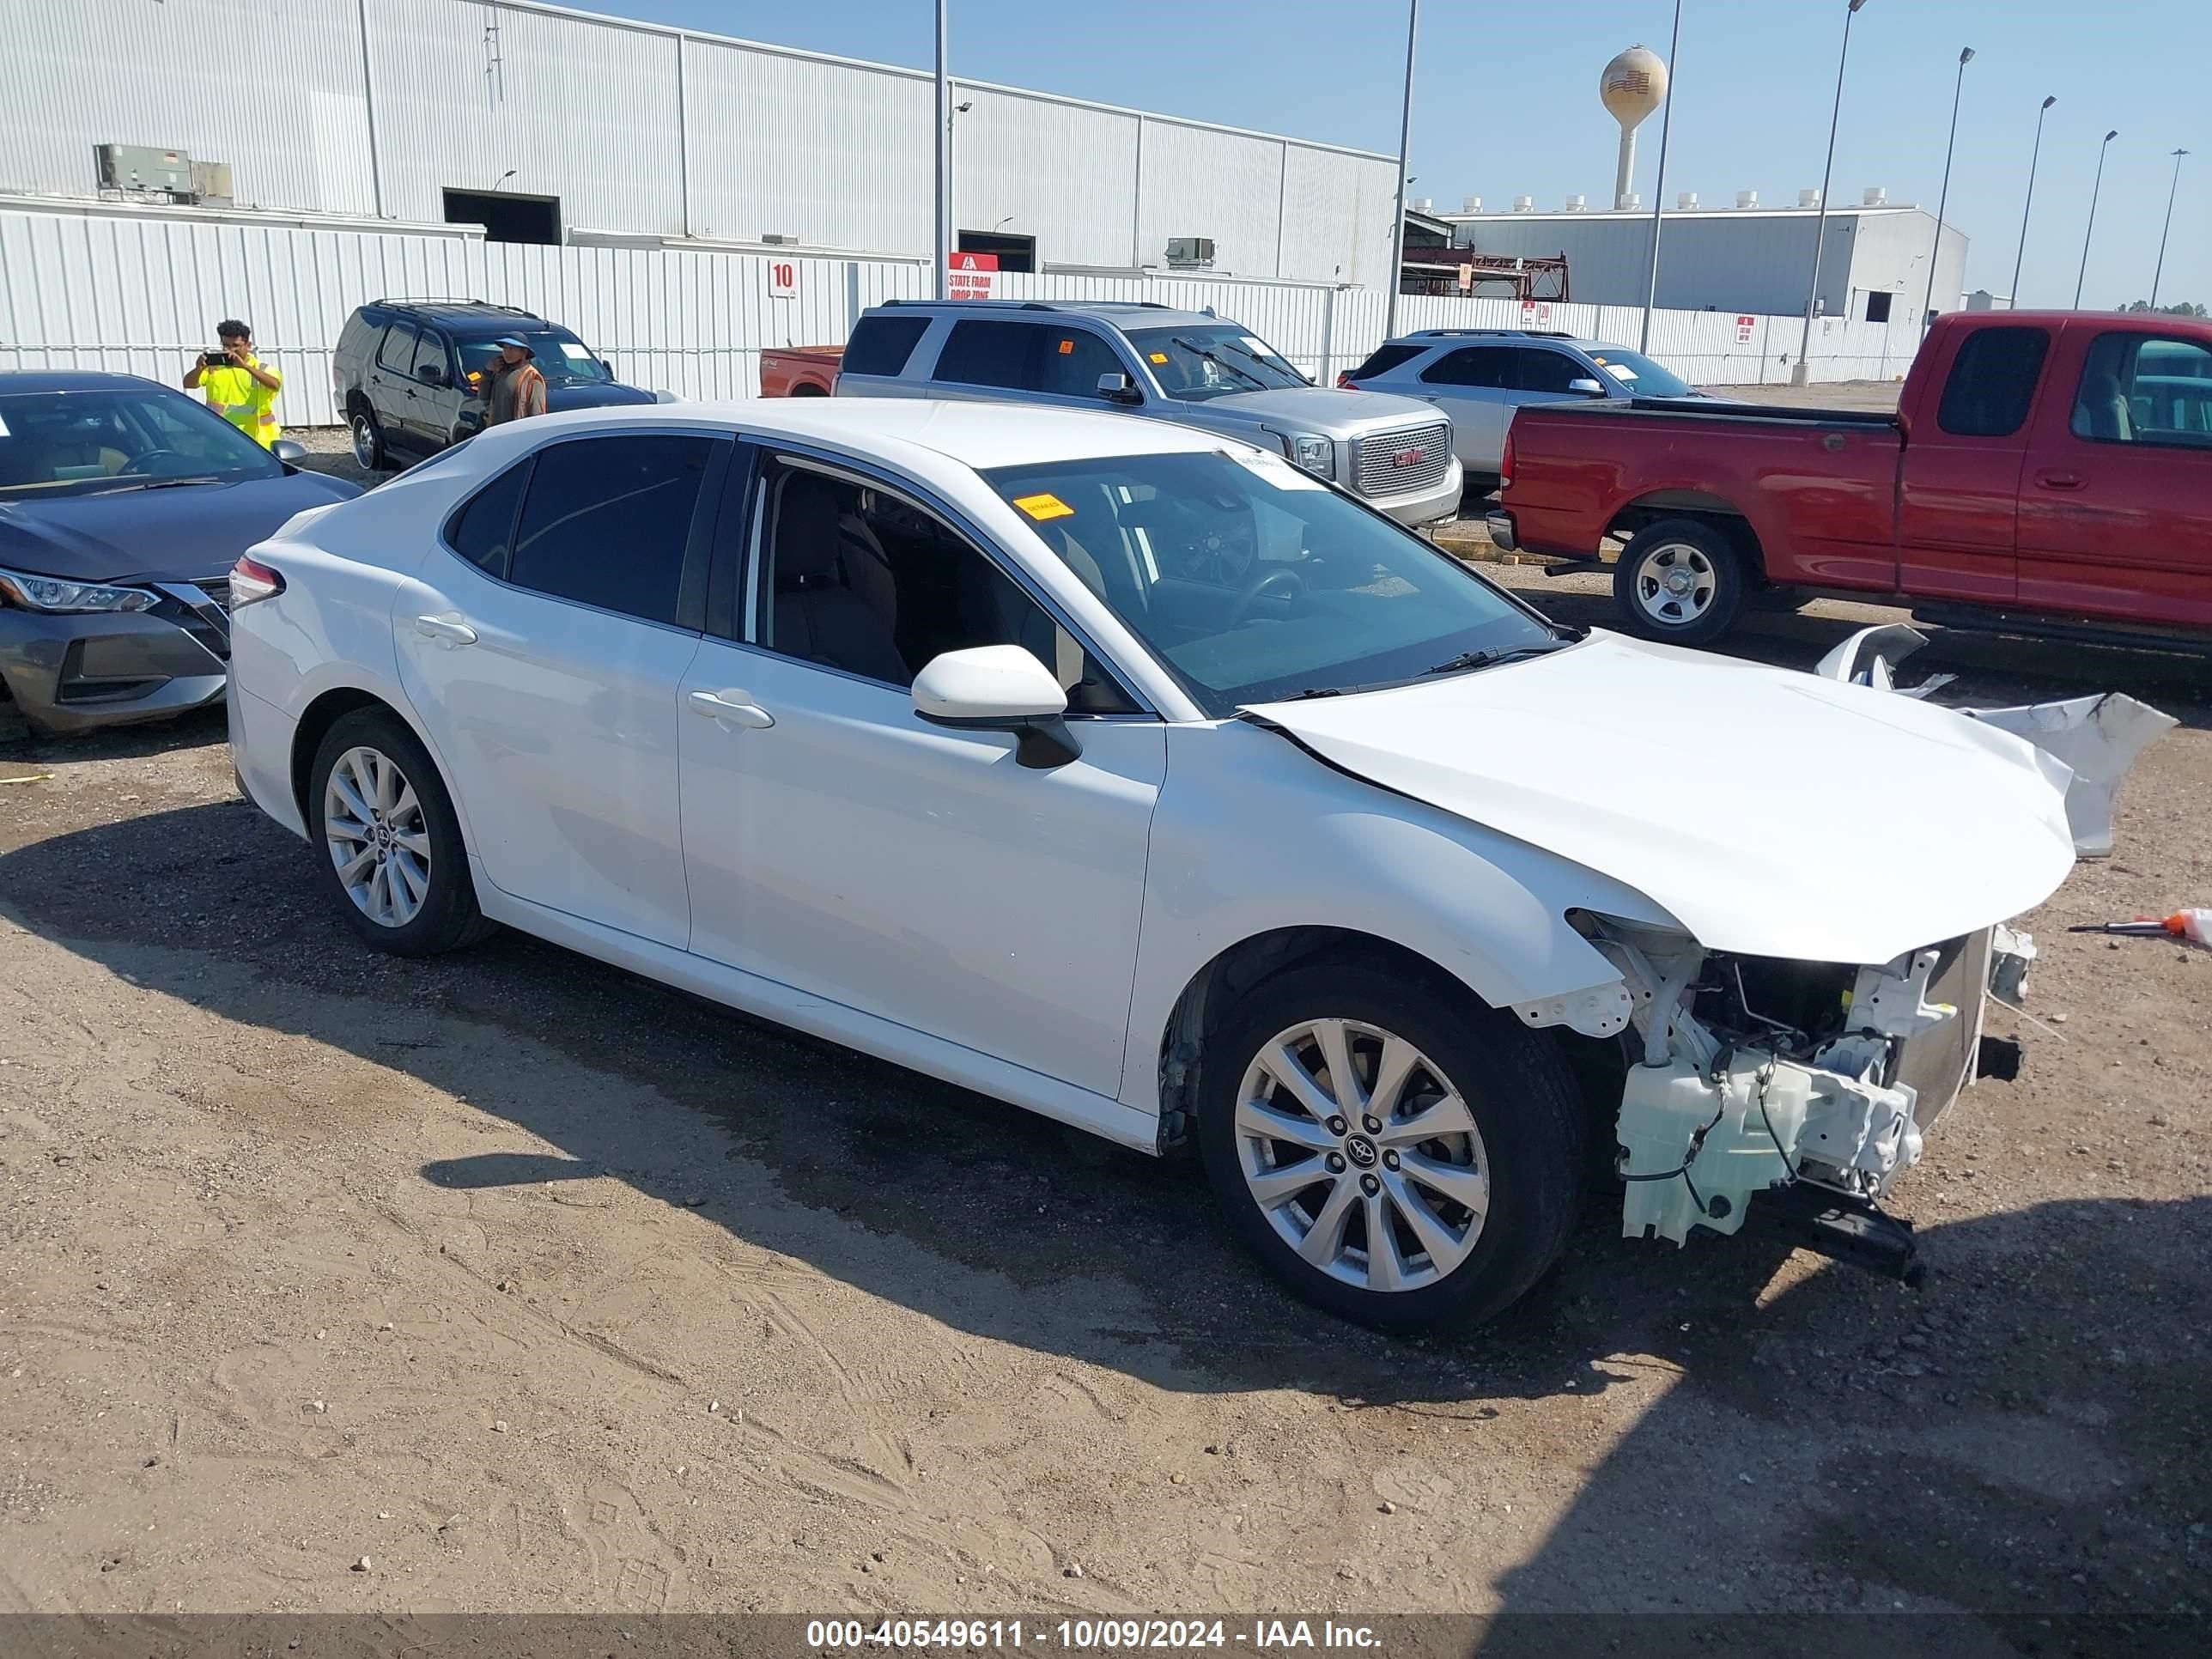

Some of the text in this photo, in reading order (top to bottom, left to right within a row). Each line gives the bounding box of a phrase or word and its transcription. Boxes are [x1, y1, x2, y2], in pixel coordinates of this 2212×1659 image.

[774, 264, 793, 287] 10
[949, 275, 991, 289] STATE FARM
[951, 289, 989, 301] DROP ZONE
[1541, 305, 1549, 319] 20
[1027, 501, 1060, 512] DETAILED
